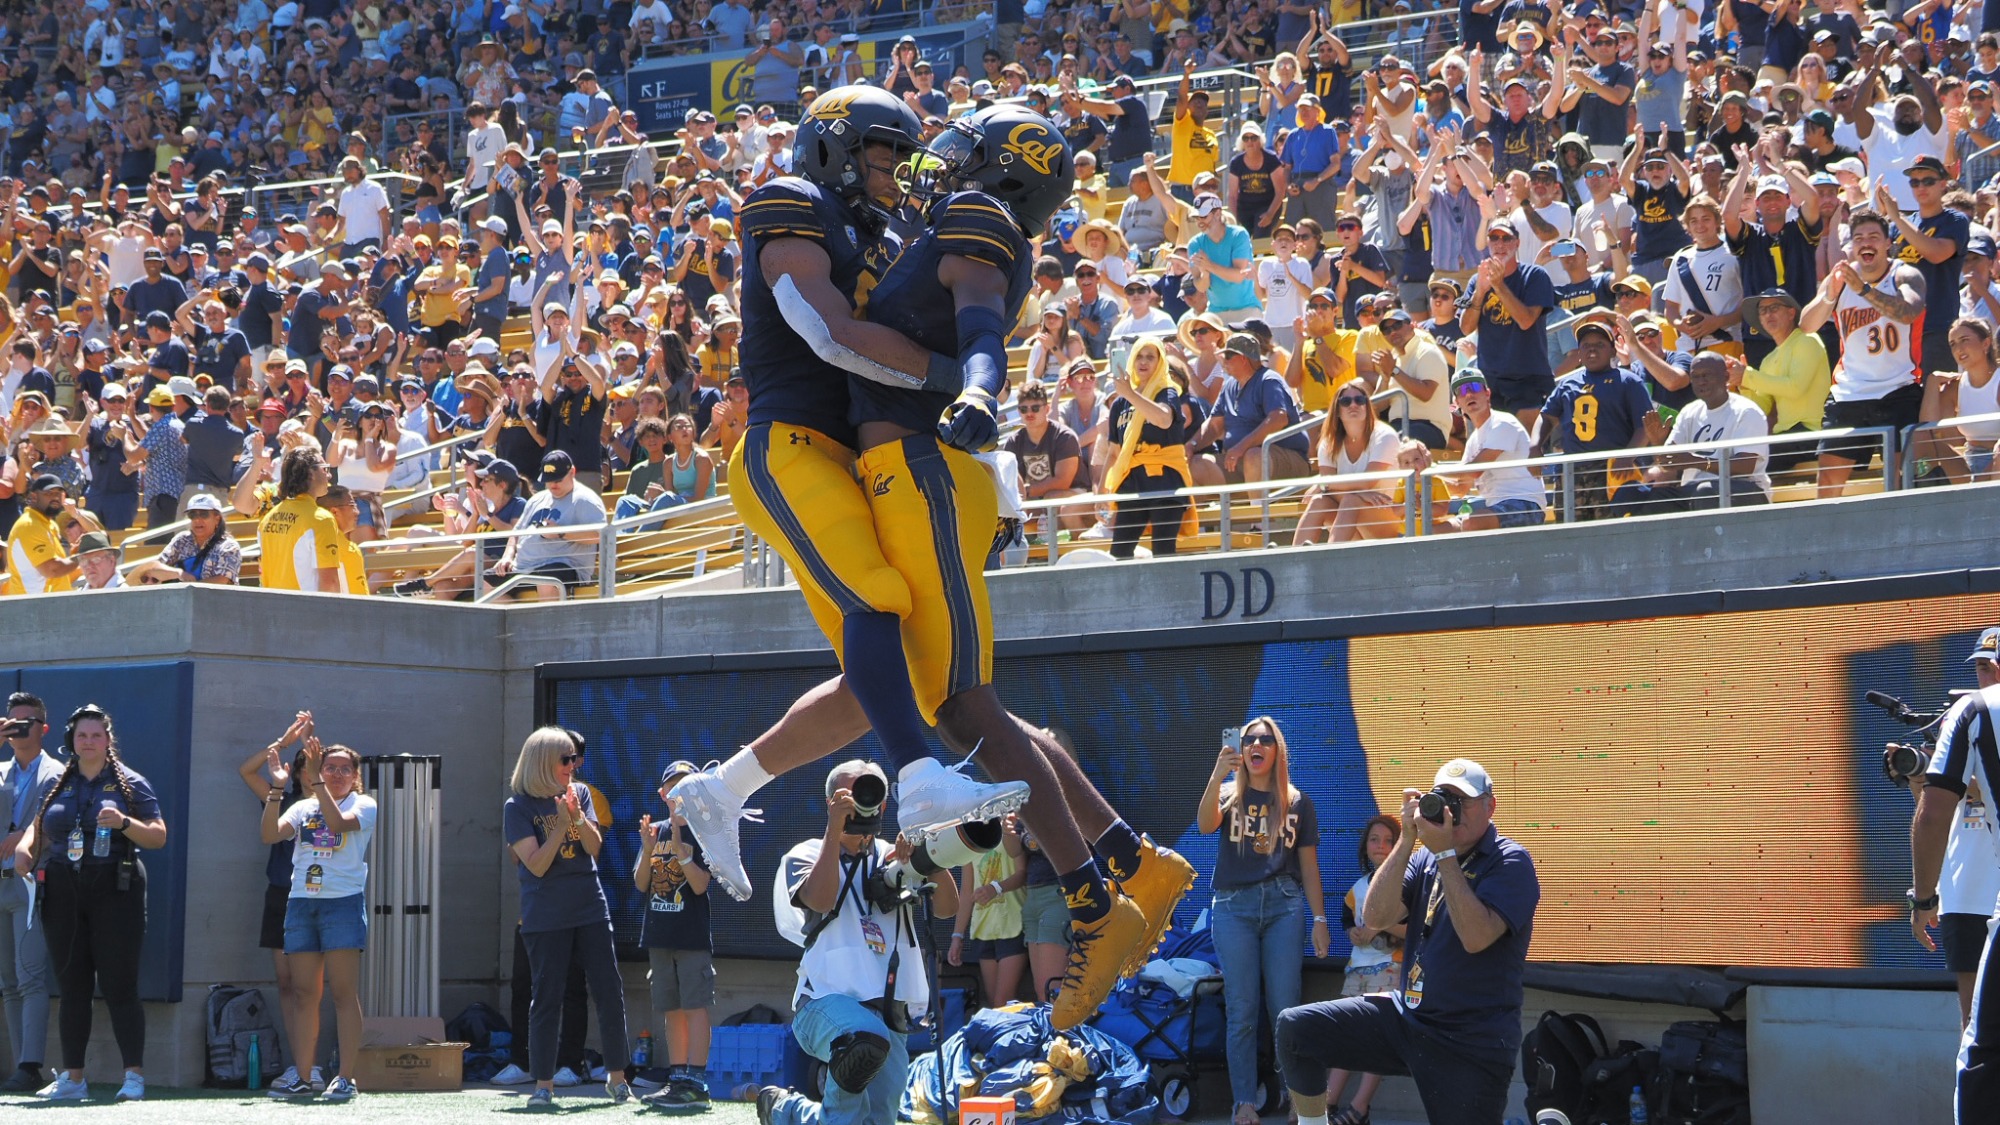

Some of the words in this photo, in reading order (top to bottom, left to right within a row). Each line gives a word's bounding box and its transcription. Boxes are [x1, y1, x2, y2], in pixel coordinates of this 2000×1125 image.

[655, 80, 666, 98] F
[655, 102, 671, 110] Rows
[655, 111, 672, 120] Seats
[804, 93, 865, 124] Cal
[1001, 123, 1063, 175] Cal
[1707, 262, 1725, 273] Cal
[1769, 246, 1785, 286] 1
[1705, 275, 1722, 291] 27
[1840, 306, 1881, 338] WARRI
[1867, 322, 1899, 354] 30
[1572, 394, 1598, 442] 8
[873, 473, 895, 497] Cal
[269, 511, 299, 524] NDMARK
[1200, 568, 1275, 620] DD
[1248, 804, 1269, 817] CA
[1229, 806, 1299, 849] BEAS
[1061, 882, 1094, 909] al
